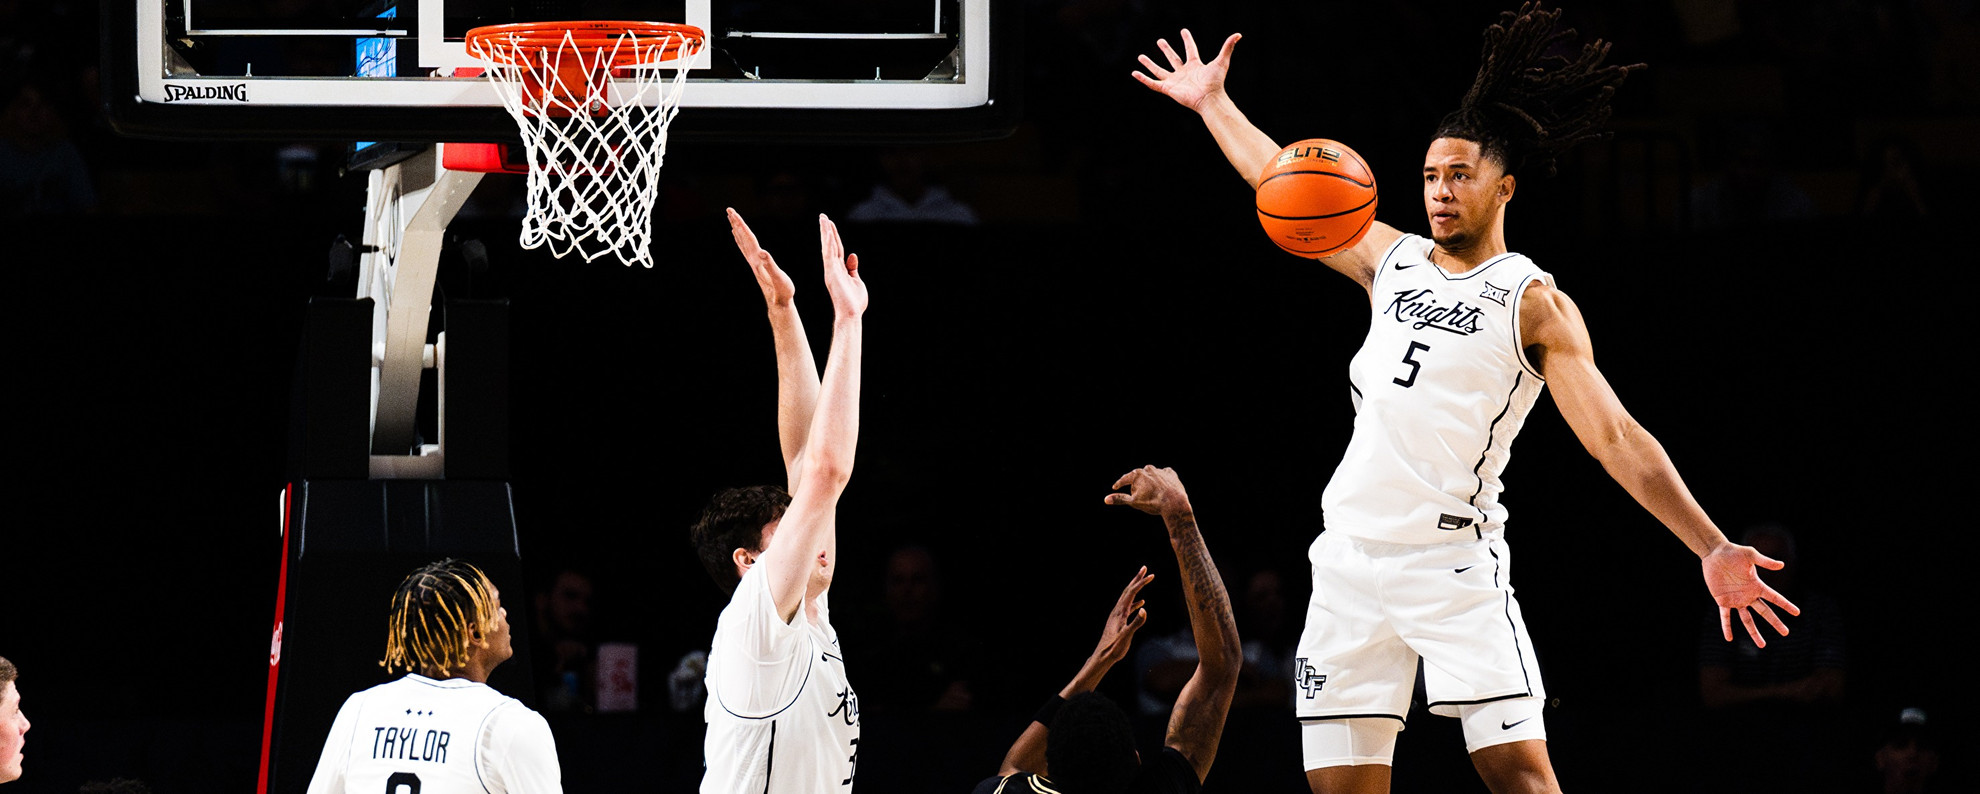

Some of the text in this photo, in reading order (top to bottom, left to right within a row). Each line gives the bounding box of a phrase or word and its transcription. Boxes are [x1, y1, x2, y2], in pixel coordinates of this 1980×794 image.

[164, 84, 248, 102] SPALDING
[1384, 289, 1485, 336] Knights
[1392, 340, 1431, 389] 5
[1295, 657, 1327, 699] UCF
[372, 726, 451, 764] TAYLOR
